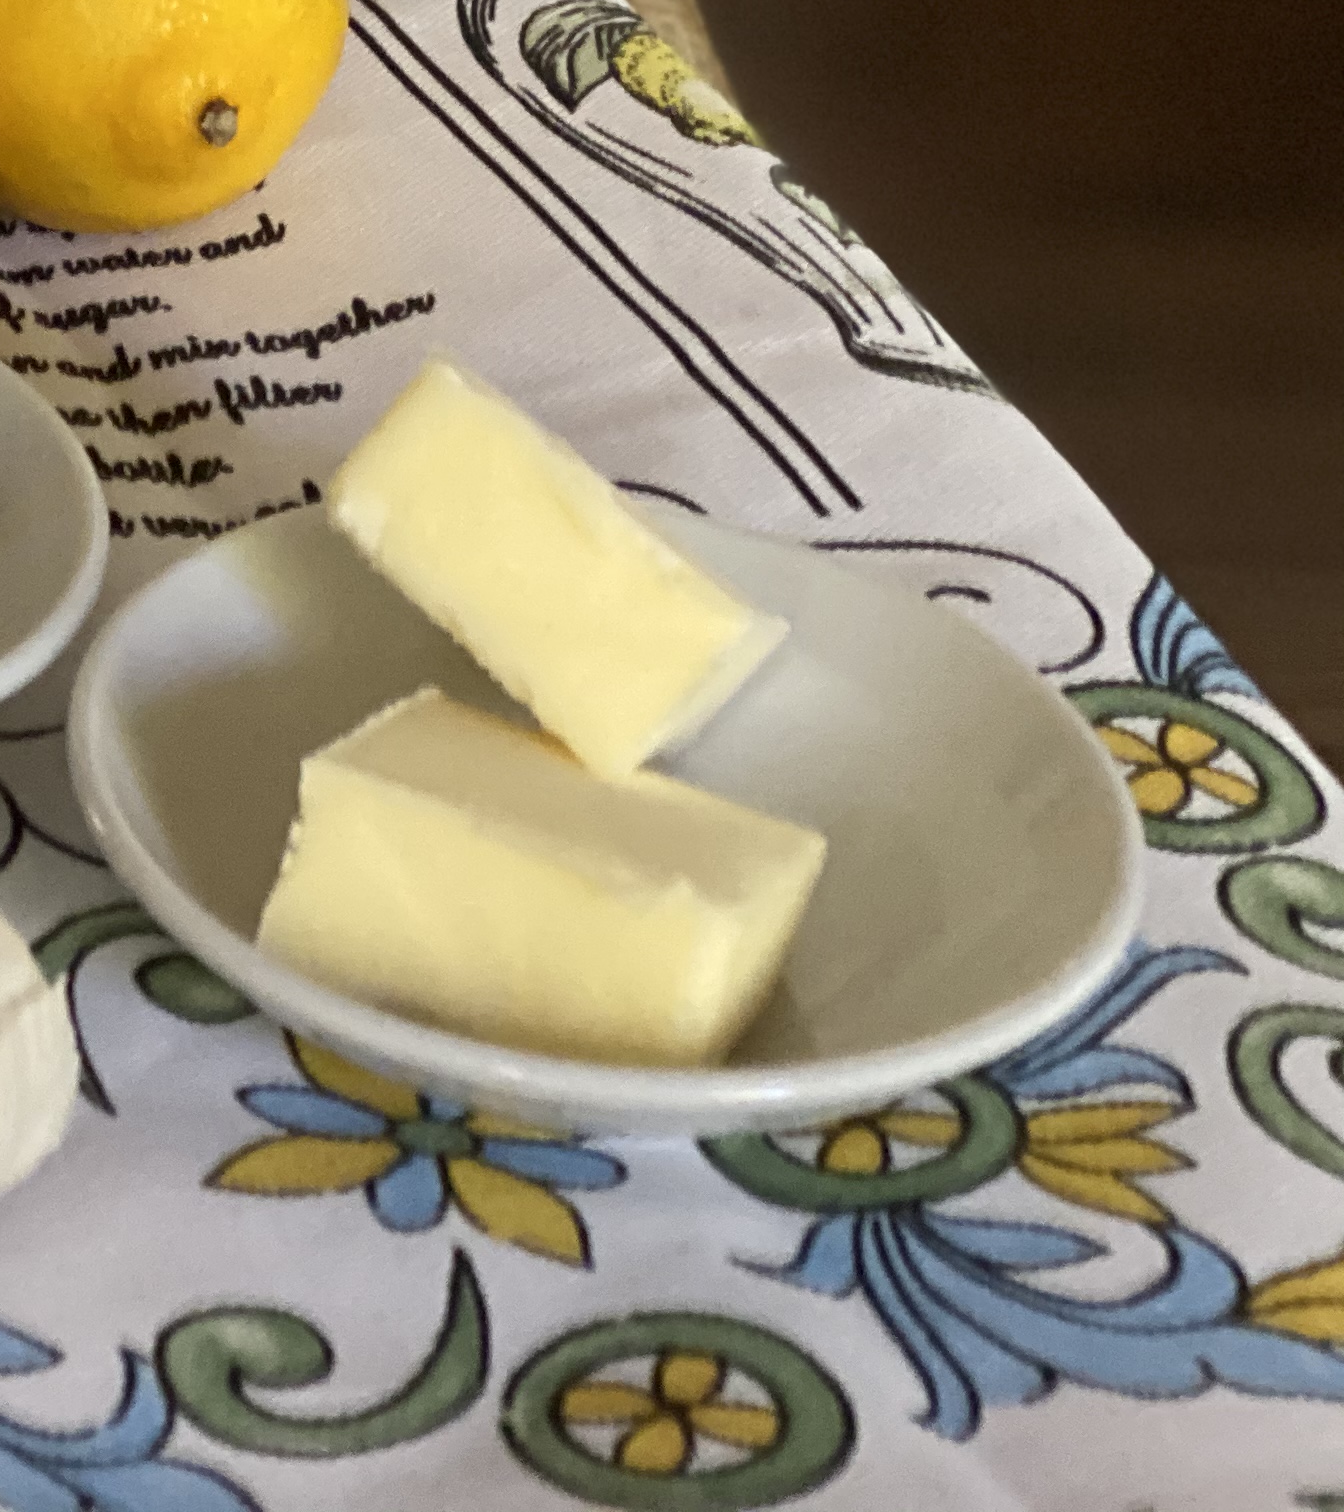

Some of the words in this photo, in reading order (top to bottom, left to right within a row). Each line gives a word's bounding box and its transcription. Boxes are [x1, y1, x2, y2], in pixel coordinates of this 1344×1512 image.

[199, 214, 286, 261] and
[55, 343, 142, 383] and
[245, 289, 436, 359] together
